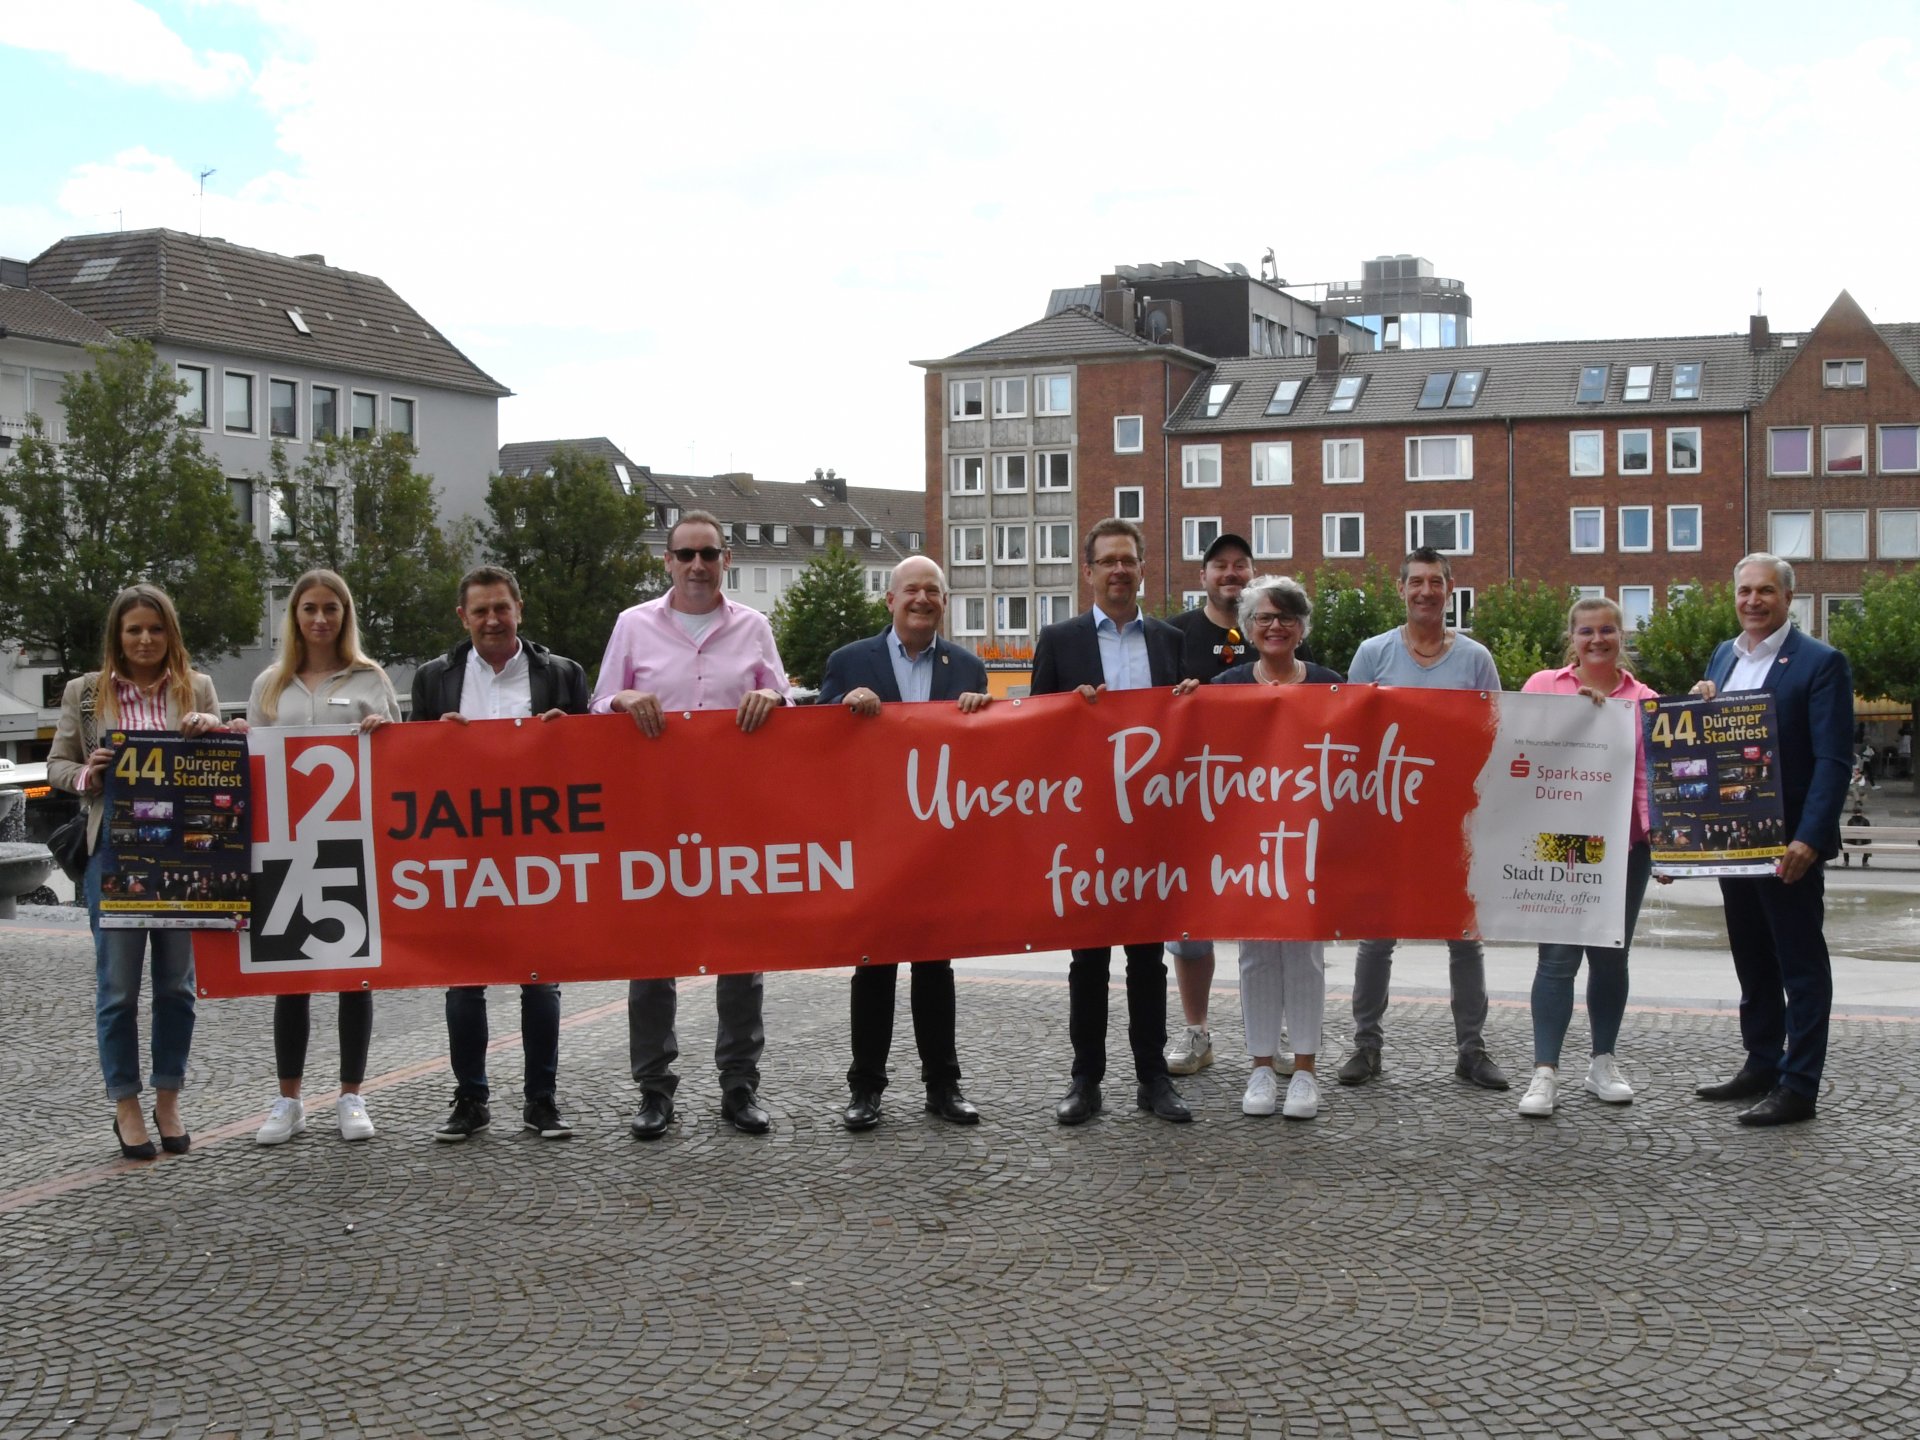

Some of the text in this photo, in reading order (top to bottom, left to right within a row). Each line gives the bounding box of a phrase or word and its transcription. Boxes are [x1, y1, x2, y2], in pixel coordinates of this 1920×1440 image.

[1651, 710, 1701, 748] 44.
[1703, 714, 1761, 729] Dürener
[1704, 726, 1768, 744] Stadtfest
[115, 747, 169, 786] 44.
[174, 755, 236, 771] Dürener
[1537, 766, 1612, 782] Sparkasse
[173, 772, 242, 787] Stadtfest
[907, 723, 1435, 829] Unsere Partnerstädte
[1536, 786, 1583, 801] Düren
[387, 783, 605, 841] JAHRE
[392, 832, 854, 910] STADT DÜREN
[1045, 818, 1319, 917] feiern mit!
[1503, 858, 1602, 884] Stadt Düren
[1571, 891, 1601, 905] offen
